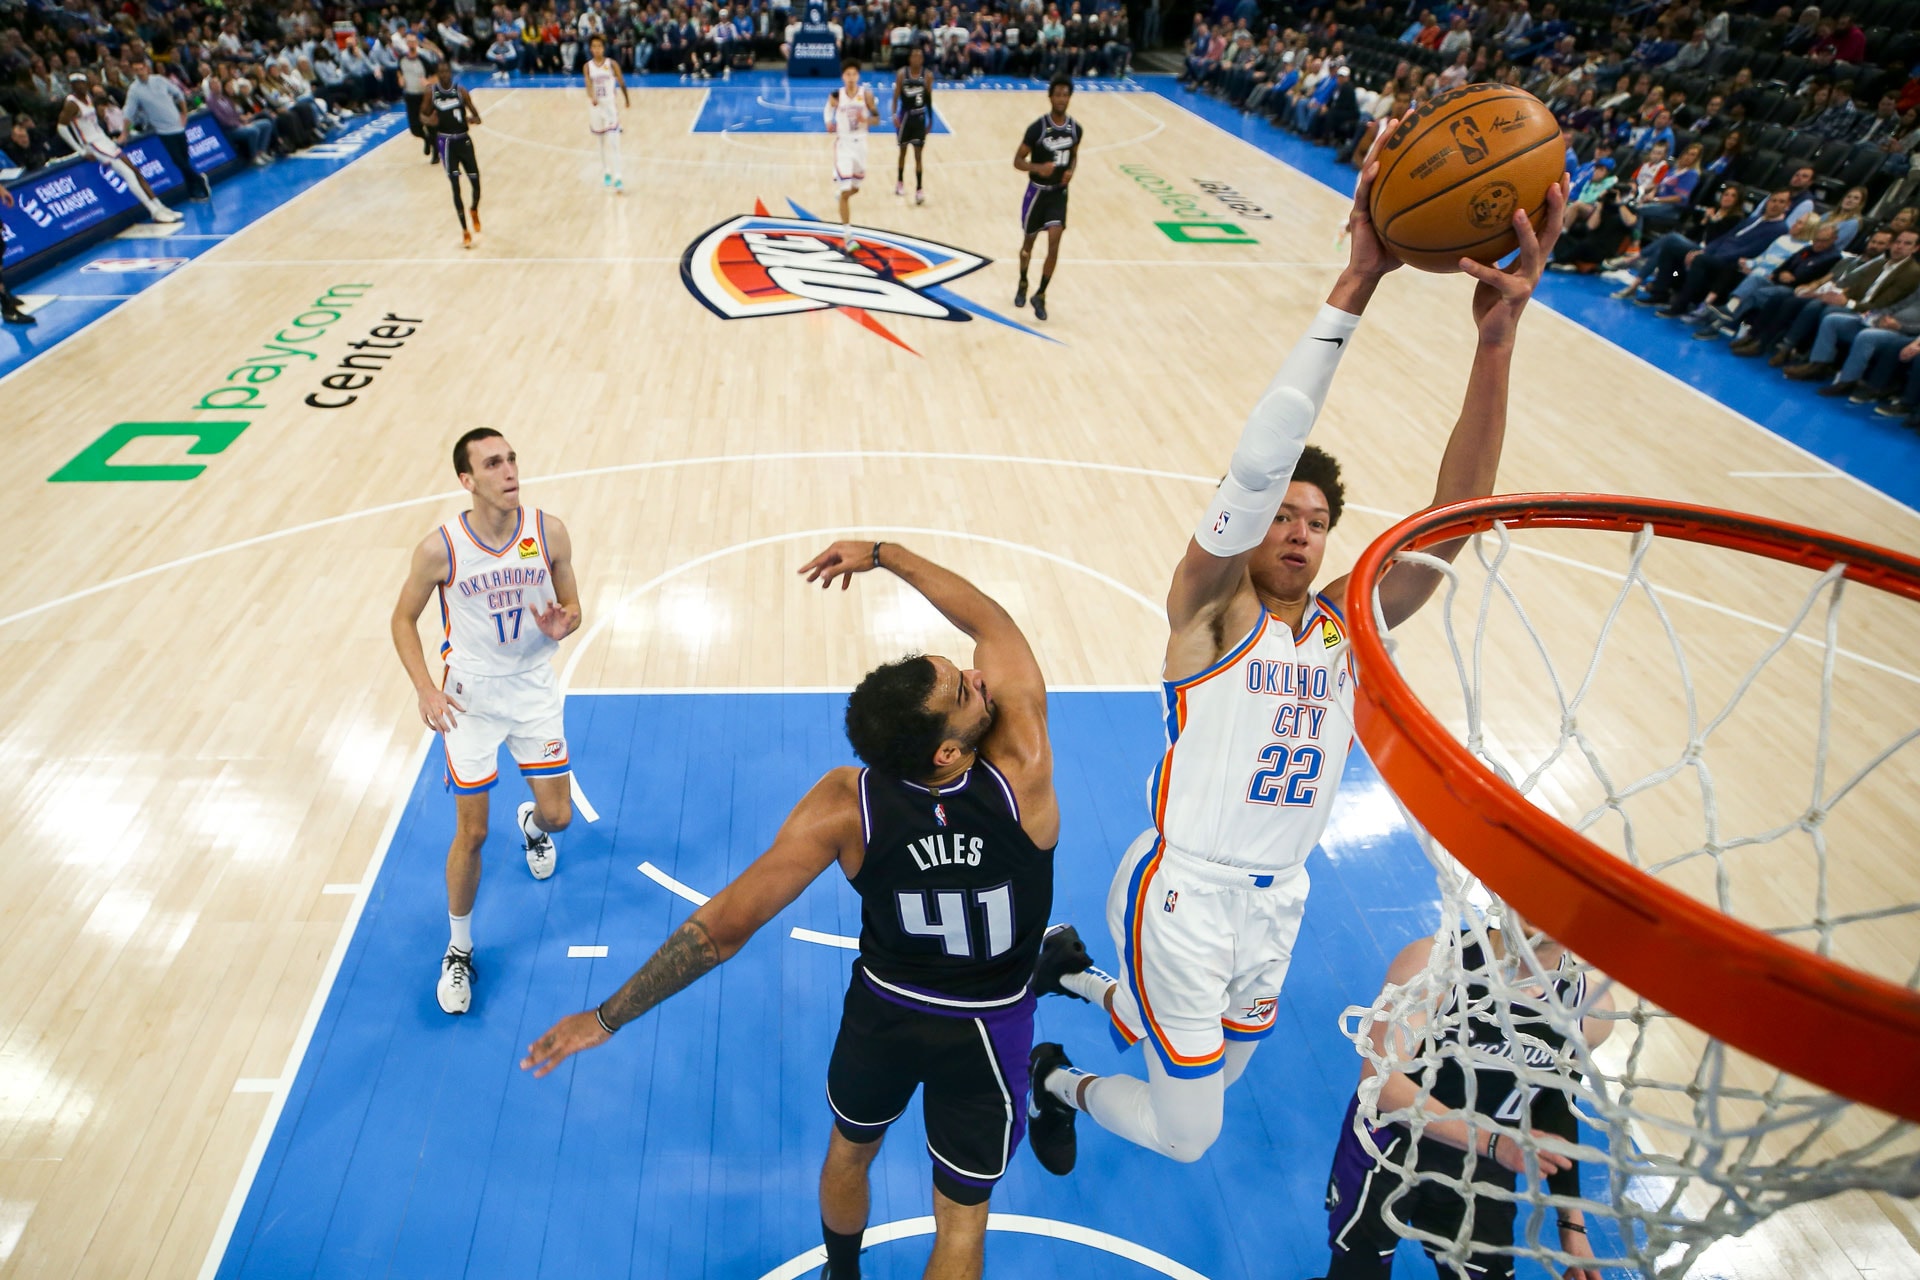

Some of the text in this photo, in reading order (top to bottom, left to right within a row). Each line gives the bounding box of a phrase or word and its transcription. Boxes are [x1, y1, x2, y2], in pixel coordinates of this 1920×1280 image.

[35, 175, 77, 204] ENERGY
[47, 187, 99, 219] TRANSFER
[192, 283, 374, 410] paycom
[304, 312, 424, 409] center
[458, 566, 548, 598] OKLAHOMA
[487, 588, 524, 611] CITY
[489, 606, 525, 646] 17
[1245, 742, 1326, 808] 22
[906, 833, 984, 871] LYLES
[893, 879, 1016, 961] 41
